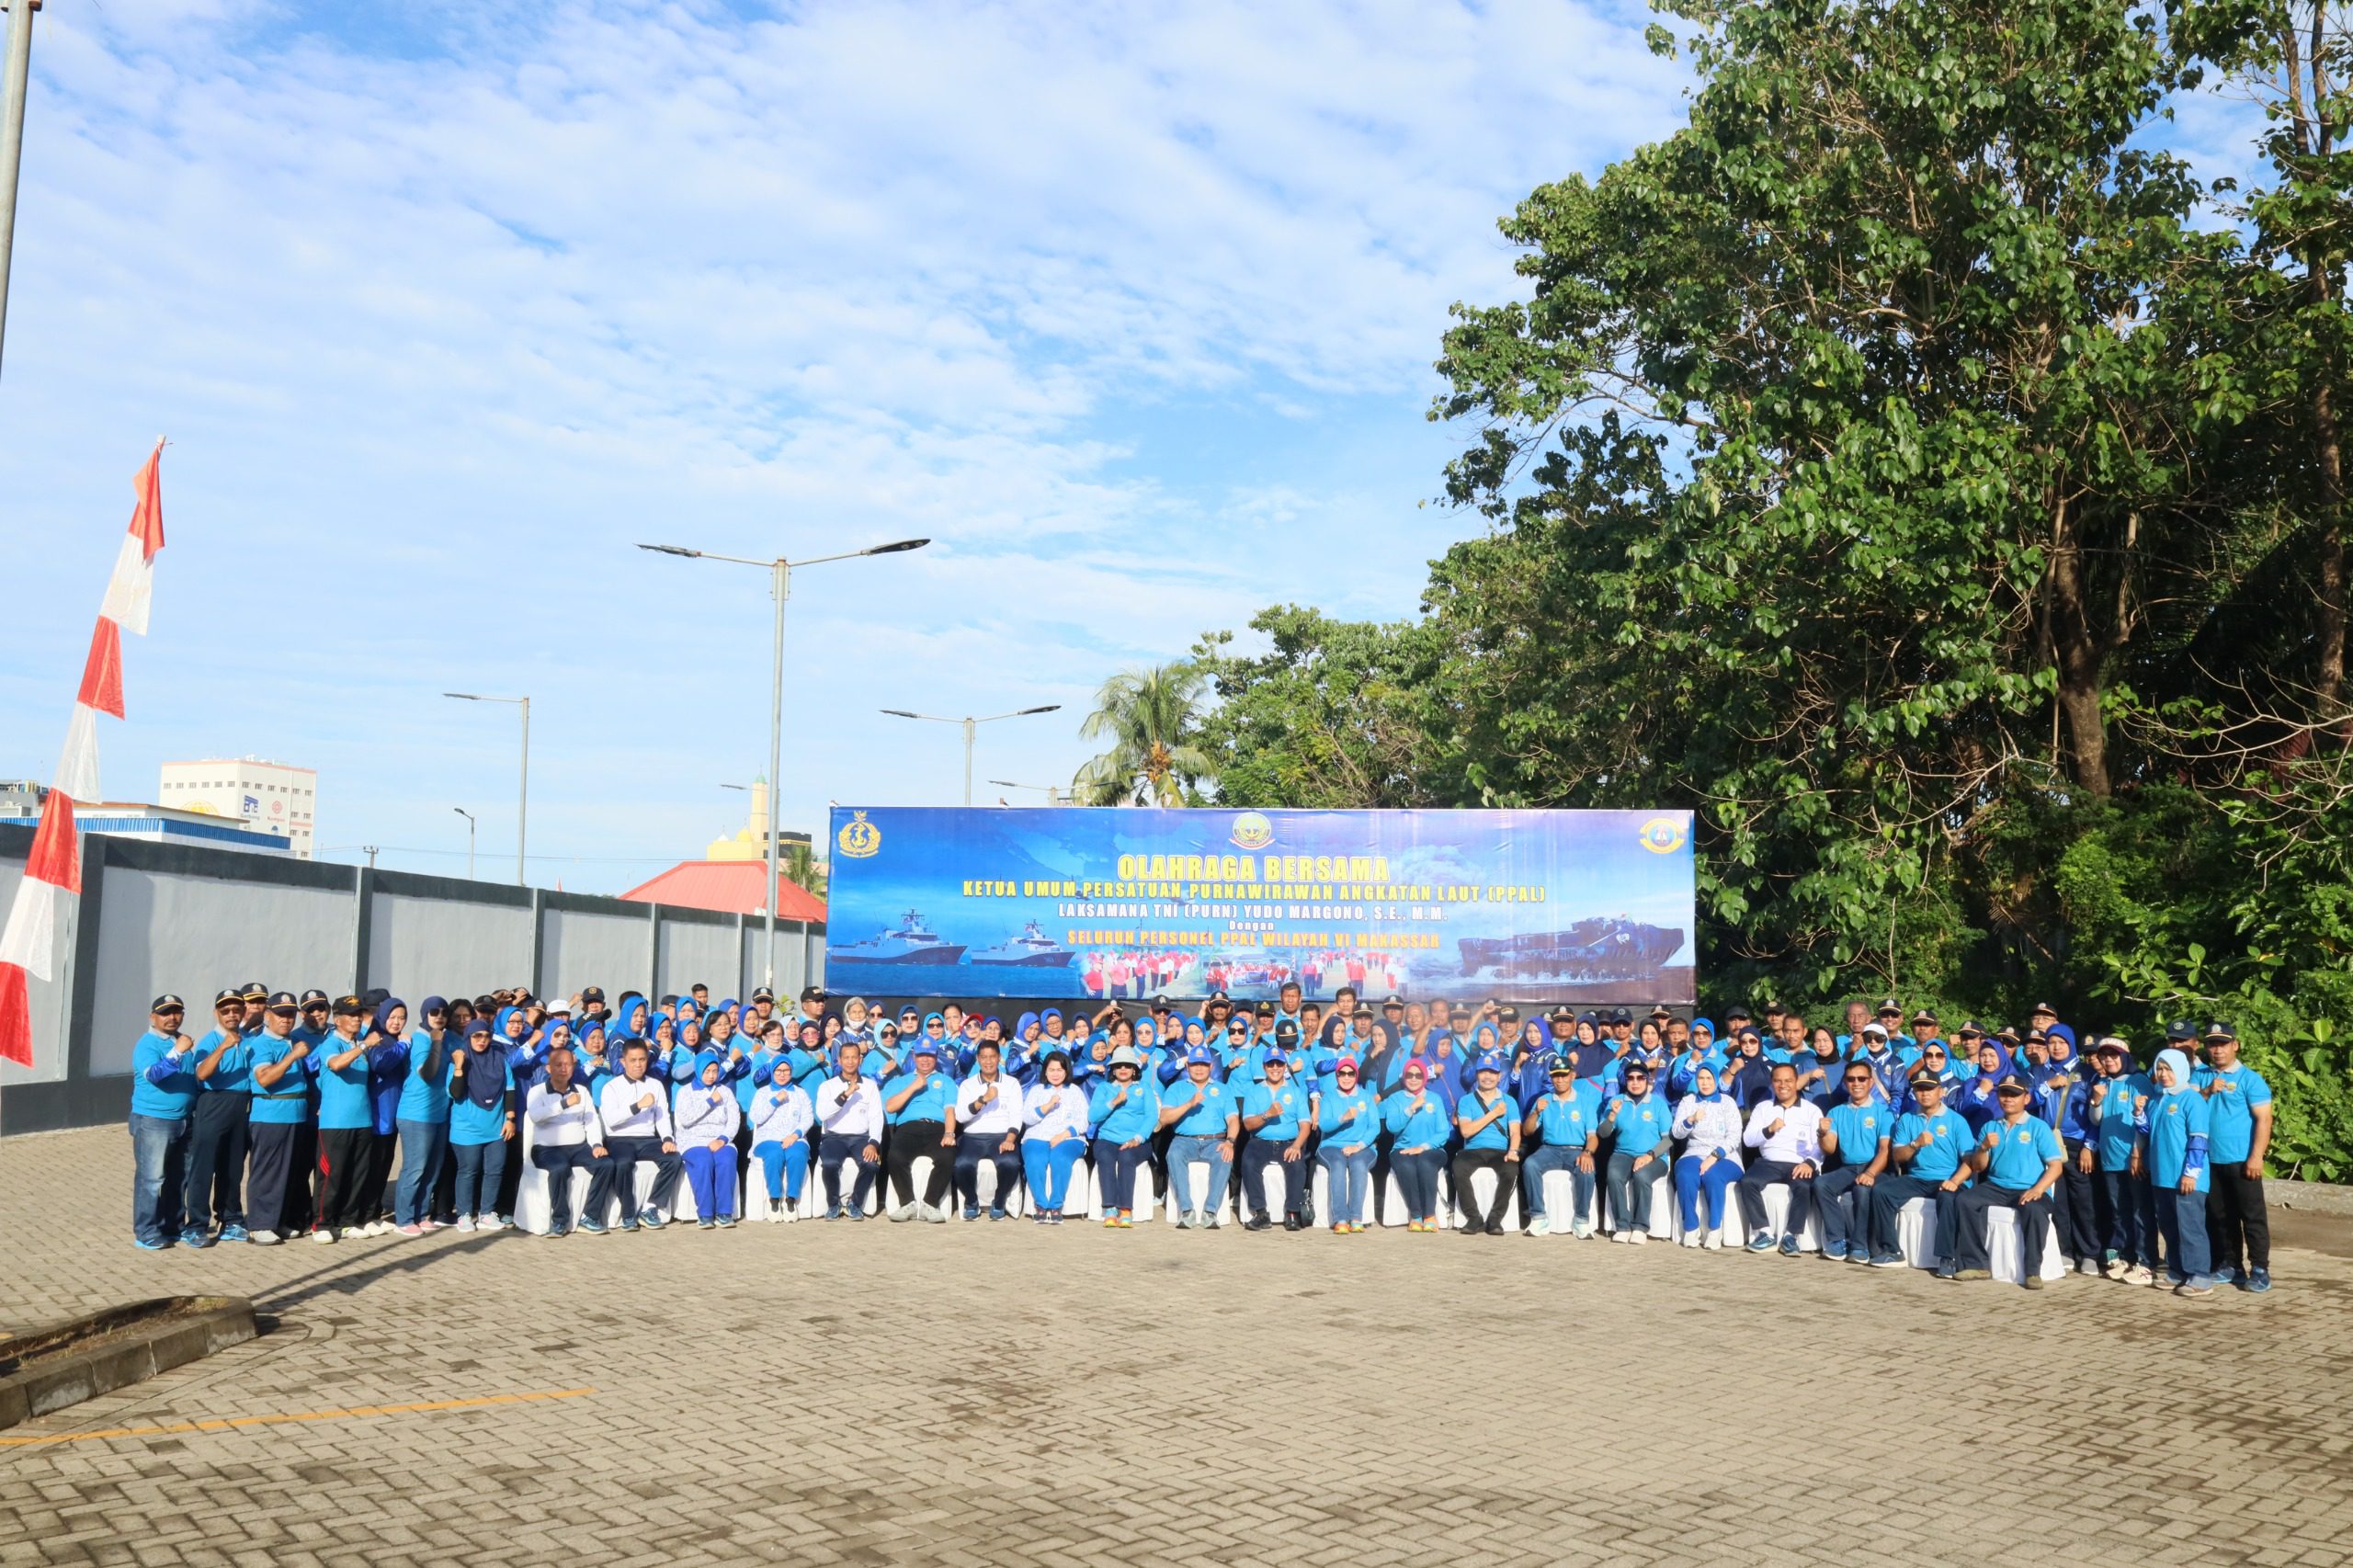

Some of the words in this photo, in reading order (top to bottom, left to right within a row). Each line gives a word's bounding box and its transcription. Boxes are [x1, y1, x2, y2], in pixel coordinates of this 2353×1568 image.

[1119, 855, 1256, 881] OLAHRAGA
[1264, 856, 1390, 882] BERSAMA
[962, 881, 1017, 897] KETUA
[1024, 881, 1075, 897] UMUM
[1083, 881, 1181, 898] PERSATUAN
[1189, 883, 1332, 900] PURNAWIRAWAN
[1339, 884, 1431, 902] ANGKATAN
[1438, 885, 1480, 902] LAUT
[1487, 886, 1545, 903] (PPAL)
[1058, 903, 1148, 917] LAKSAMANA
[1154, 903, 1178, 918] TNI
[1184, 904, 1238, 919] (PURN)
[1244, 904, 1283, 919] YUDO
[1289, 905, 1368, 921] MARGONO,
[1374, 906, 1406, 921] S.E.,
[1412, 906, 1448, 920] M.M.
[1229, 920, 1274, 932] Dengan
[1067, 930, 1134, 945] SELURUH
[1140, 931, 1214, 946] PERSONEL
[1221, 932, 1256, 947] PPAL
[1261, 933, 1328, 948] WILAYAH
[1334, 933, 1350, 948] VI
[1356, 933, 1440, 949] MAKASSAR
